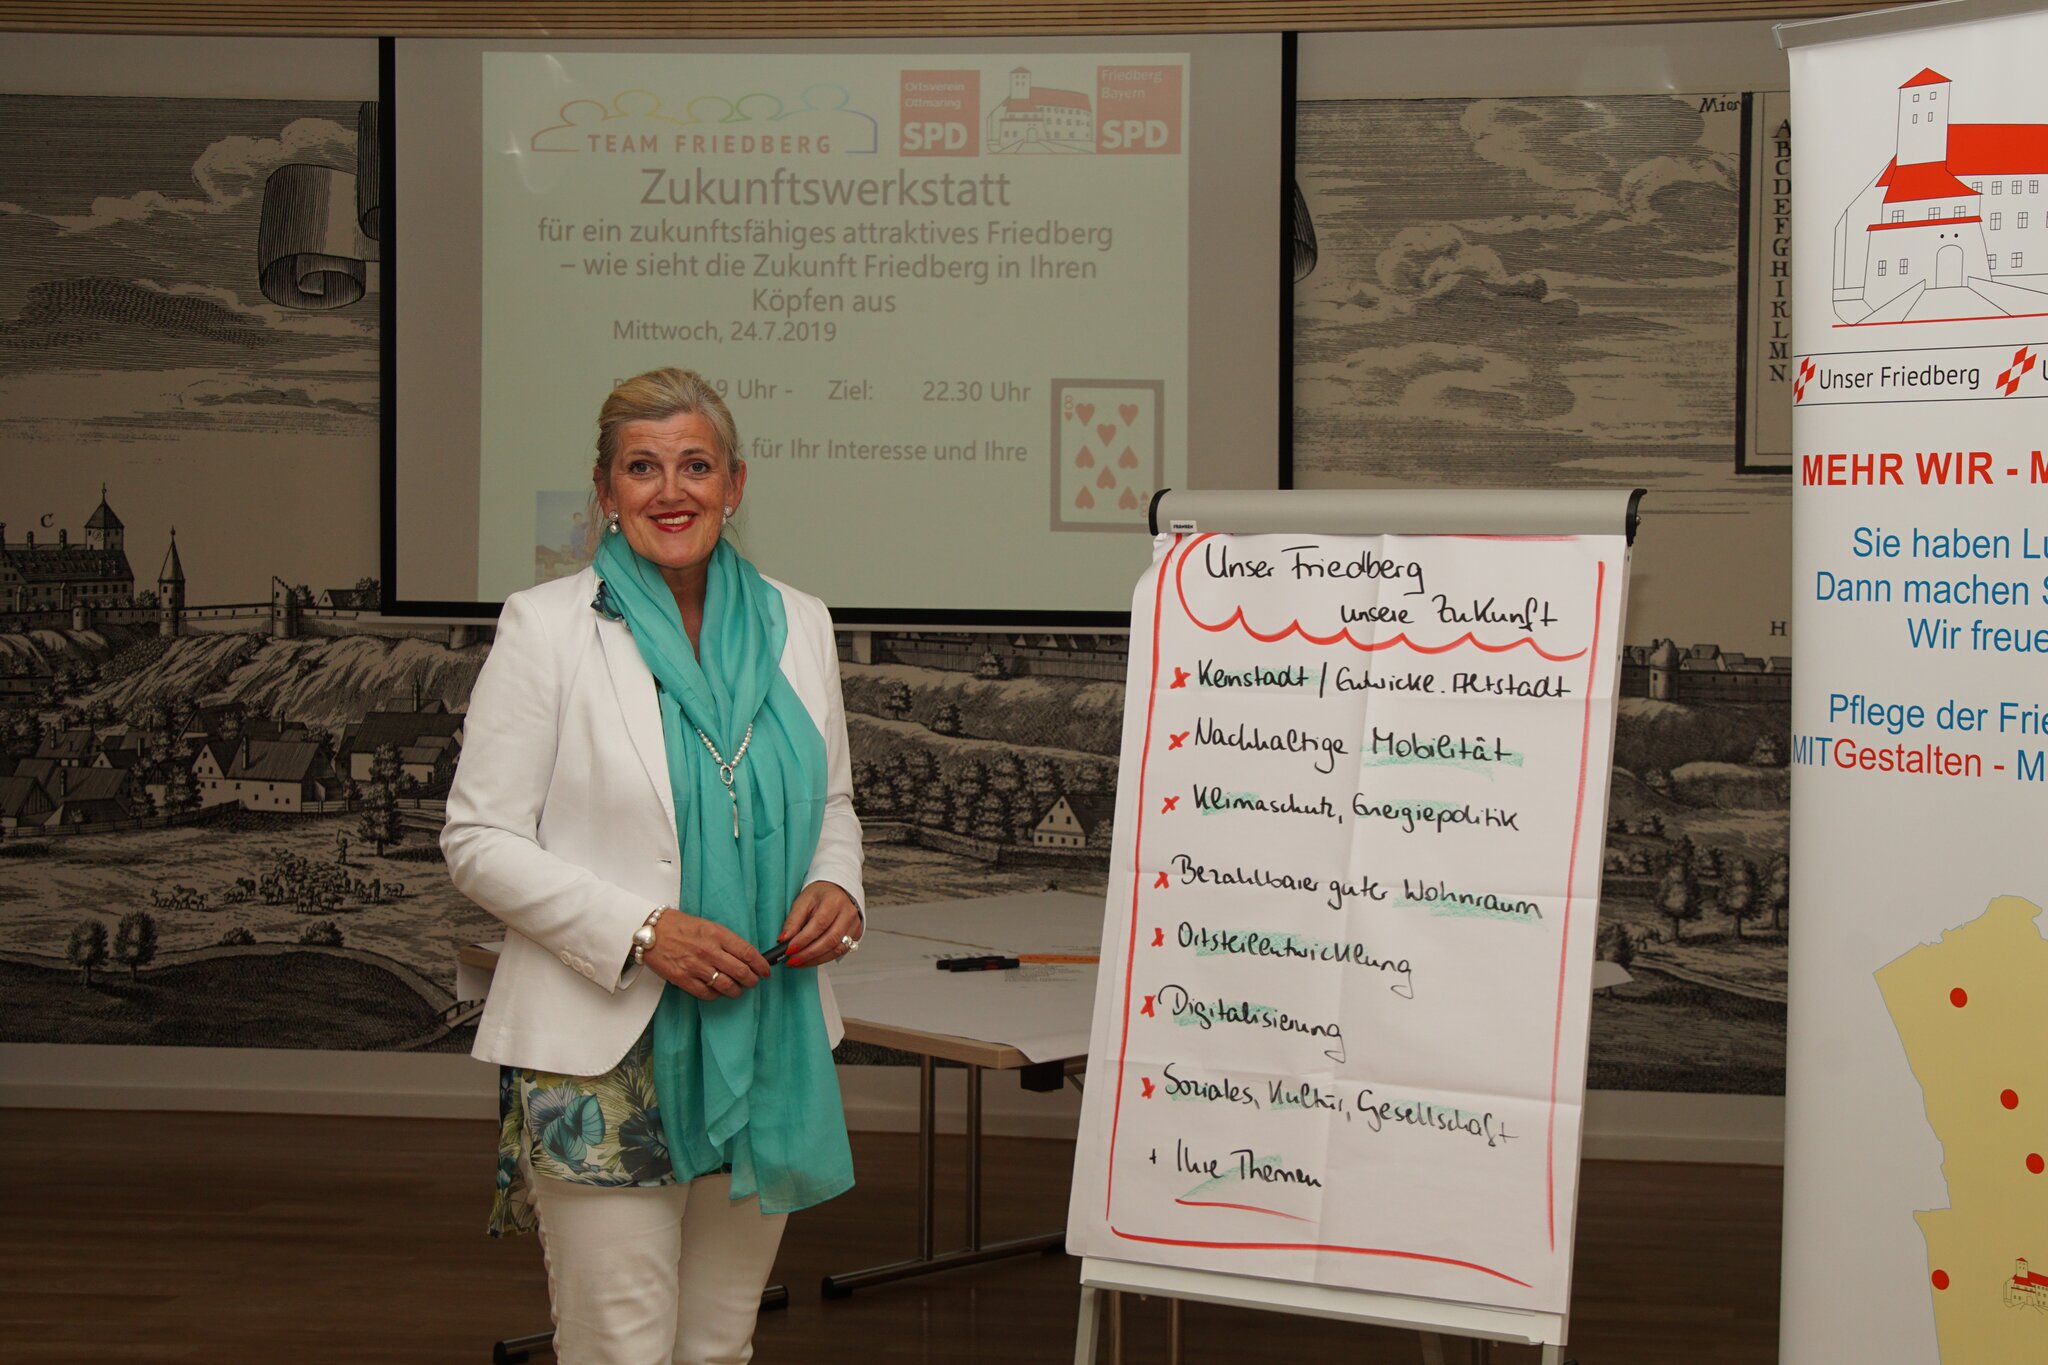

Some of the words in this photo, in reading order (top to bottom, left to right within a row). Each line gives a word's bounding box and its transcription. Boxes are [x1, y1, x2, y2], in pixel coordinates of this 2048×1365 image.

[1101, 70, 1163, 83] Friedberg
[1101, 87, 1146, 99] Bayern
[587, 134, 657, 153] TEAM
[675, 135, 829, 154] FRIEDBERG
[903, 122, 968, 150] SPD
[1102, 120, 1168, 148] SPD
[640, 167, 1010, 206] Zukunftswerkstatt
[538, 217, 575, 242] für
[583, 218, 621, 242] ein
[630, 218, 835, 250] zukunftsfähiges
[843, 220, 979, 244] attraktives
[988, 220, 1112, 252] Friedberg
[583, 252, 627, 276] wie
[636, 252, 698, 277] sieht
[706, 252, 745, 277] die
[753, 253, 856, 277] Zukunft
[865, 254, 988, 285] Friedberg
[998, 254, 1020, 278] in
[1031, 254, 1096, 279] Ihren
[753, 287, 843, 318] Köpfen
[853, 295, 896, 313] aus
[614, 320, 722, 343] Mittwoch,
[731, 321, 836, 342] 24.7.2019
[738, 379, 777, 399] Uhr
[828, 380, 872, 400] Ziel:
[923, 381, 982, 402] 22.30
[991, 381, 1031, 402] Uhr
[1820, 369, 1873, 389] Unser
[1881, 365, 1979, 390] Friedberg
[752, 437, 783, 458] für
[791, 438, 820, 458] Ihr
[828, 439, 927, 460] Interesse
[934, 440, 976, 461] und
[985, 440, 1027, 462] Ihre
[1802, 453, 1904, 486] MEHR
[1916, 451, 1994, 485] WIR
[1853, 527, 1900, 557] Sie
[1913, 527, 2010, 558] haben
[2023, 528, 2048, 559] L
[1206, 544, 1274, 578] Unser
[1282, 545, 1424, 596] Friedberg
[1816, 572, 1891, 602] Dann
[1904, 574, 2029, 605] machen
[1341, 605, 1413, 624] unsere
[1432, 594, 1557, 632] Zukunft
[1770, 621, 1787, 636] H
[1908, 618, 1962, 649] Wir
[1453, 673, 1570, 698] Altstadt
[1830, 694, 1925, 735] Pflege
[1937, 700, 1988, 731] der
[1195, 717, 1348, 774] Nachhaltige
[1372, 726, 1513, 762] Mobilität
[1793, 734, 1982, 777] MITGestalten
[1352, 793, 1518, 833] Energiepolitik
[1327, 876, 1387, 910] guter
[1404, 879, 1542, 918] Wohnraum
[1158, 984, 1344, 1063] Digitalisierung
[1164, 1063, 1259, 1108] Soziales,
[1357, 1088, 1519, 1147] Gesellschaft
[1177, 1139, 1224, 1179] Ihre
[1231, 1149, 1321, 1187] Themen
